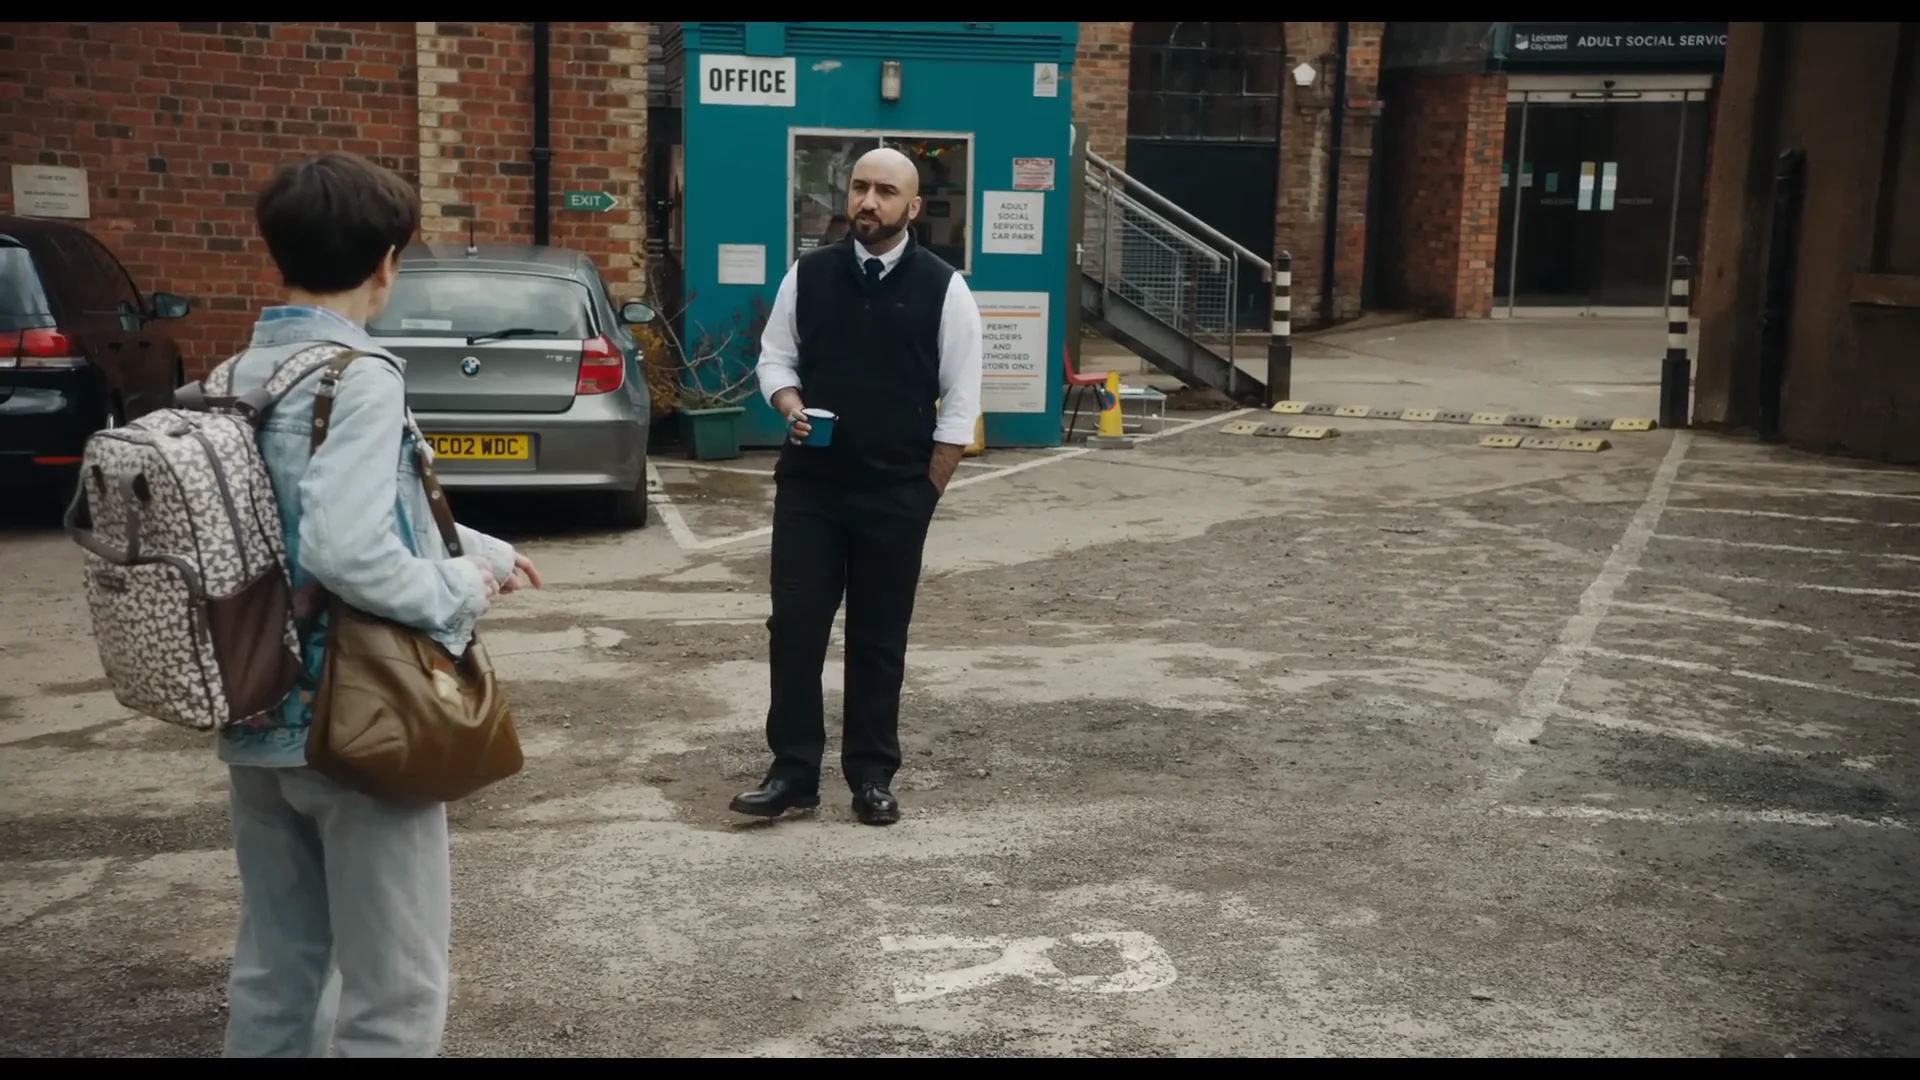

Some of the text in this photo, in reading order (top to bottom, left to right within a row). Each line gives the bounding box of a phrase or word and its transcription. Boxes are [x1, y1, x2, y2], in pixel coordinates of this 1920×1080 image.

[1531, 34, 1568, 42] Leicester
[1577, 34, 1728, 47] ADULT SOCIAL SERVIC
[709, 67, 787, 94] OFFICE
[571, 194, 602, 207] EXIT
[998, 213, 1030, 221] SOCIAL
[993, 222, 1034, 231] SERVICES
[987, 323, 1018, 331] PERMIT
[982, 333, 1022, 341] HOLDERS
[992, 343, 1011, 351] AND
[481, 438, 519, 455] WDC
